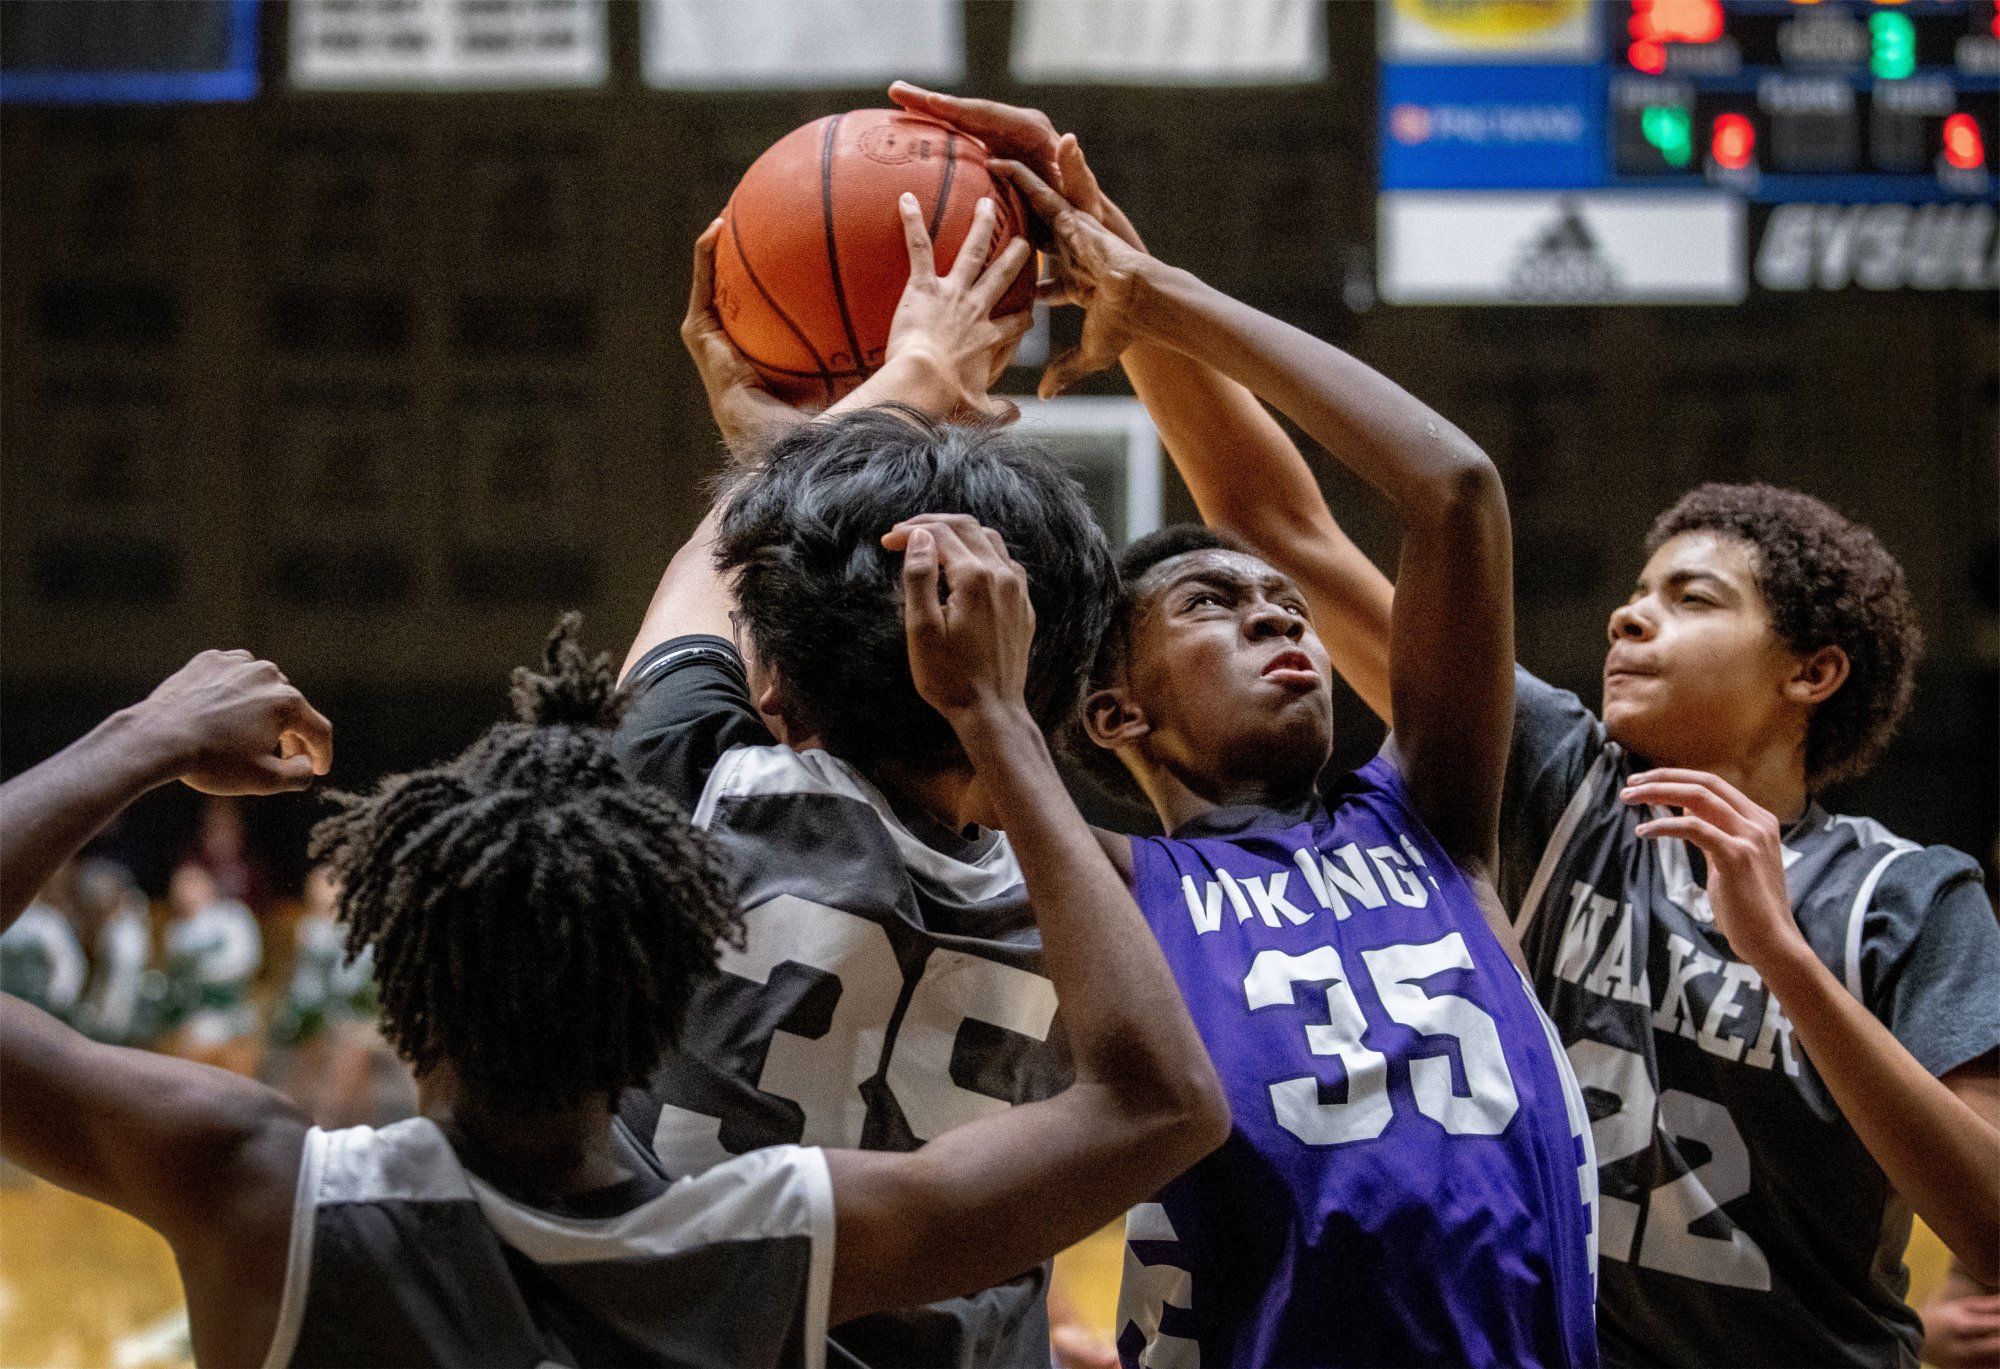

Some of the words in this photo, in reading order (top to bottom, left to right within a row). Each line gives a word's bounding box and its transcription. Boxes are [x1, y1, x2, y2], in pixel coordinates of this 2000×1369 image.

[1244, 932, 1520, 1146] 35
[1553, 880, 1800, 1078] WAKER
[1565, 1038, 1772, 1292] 22
